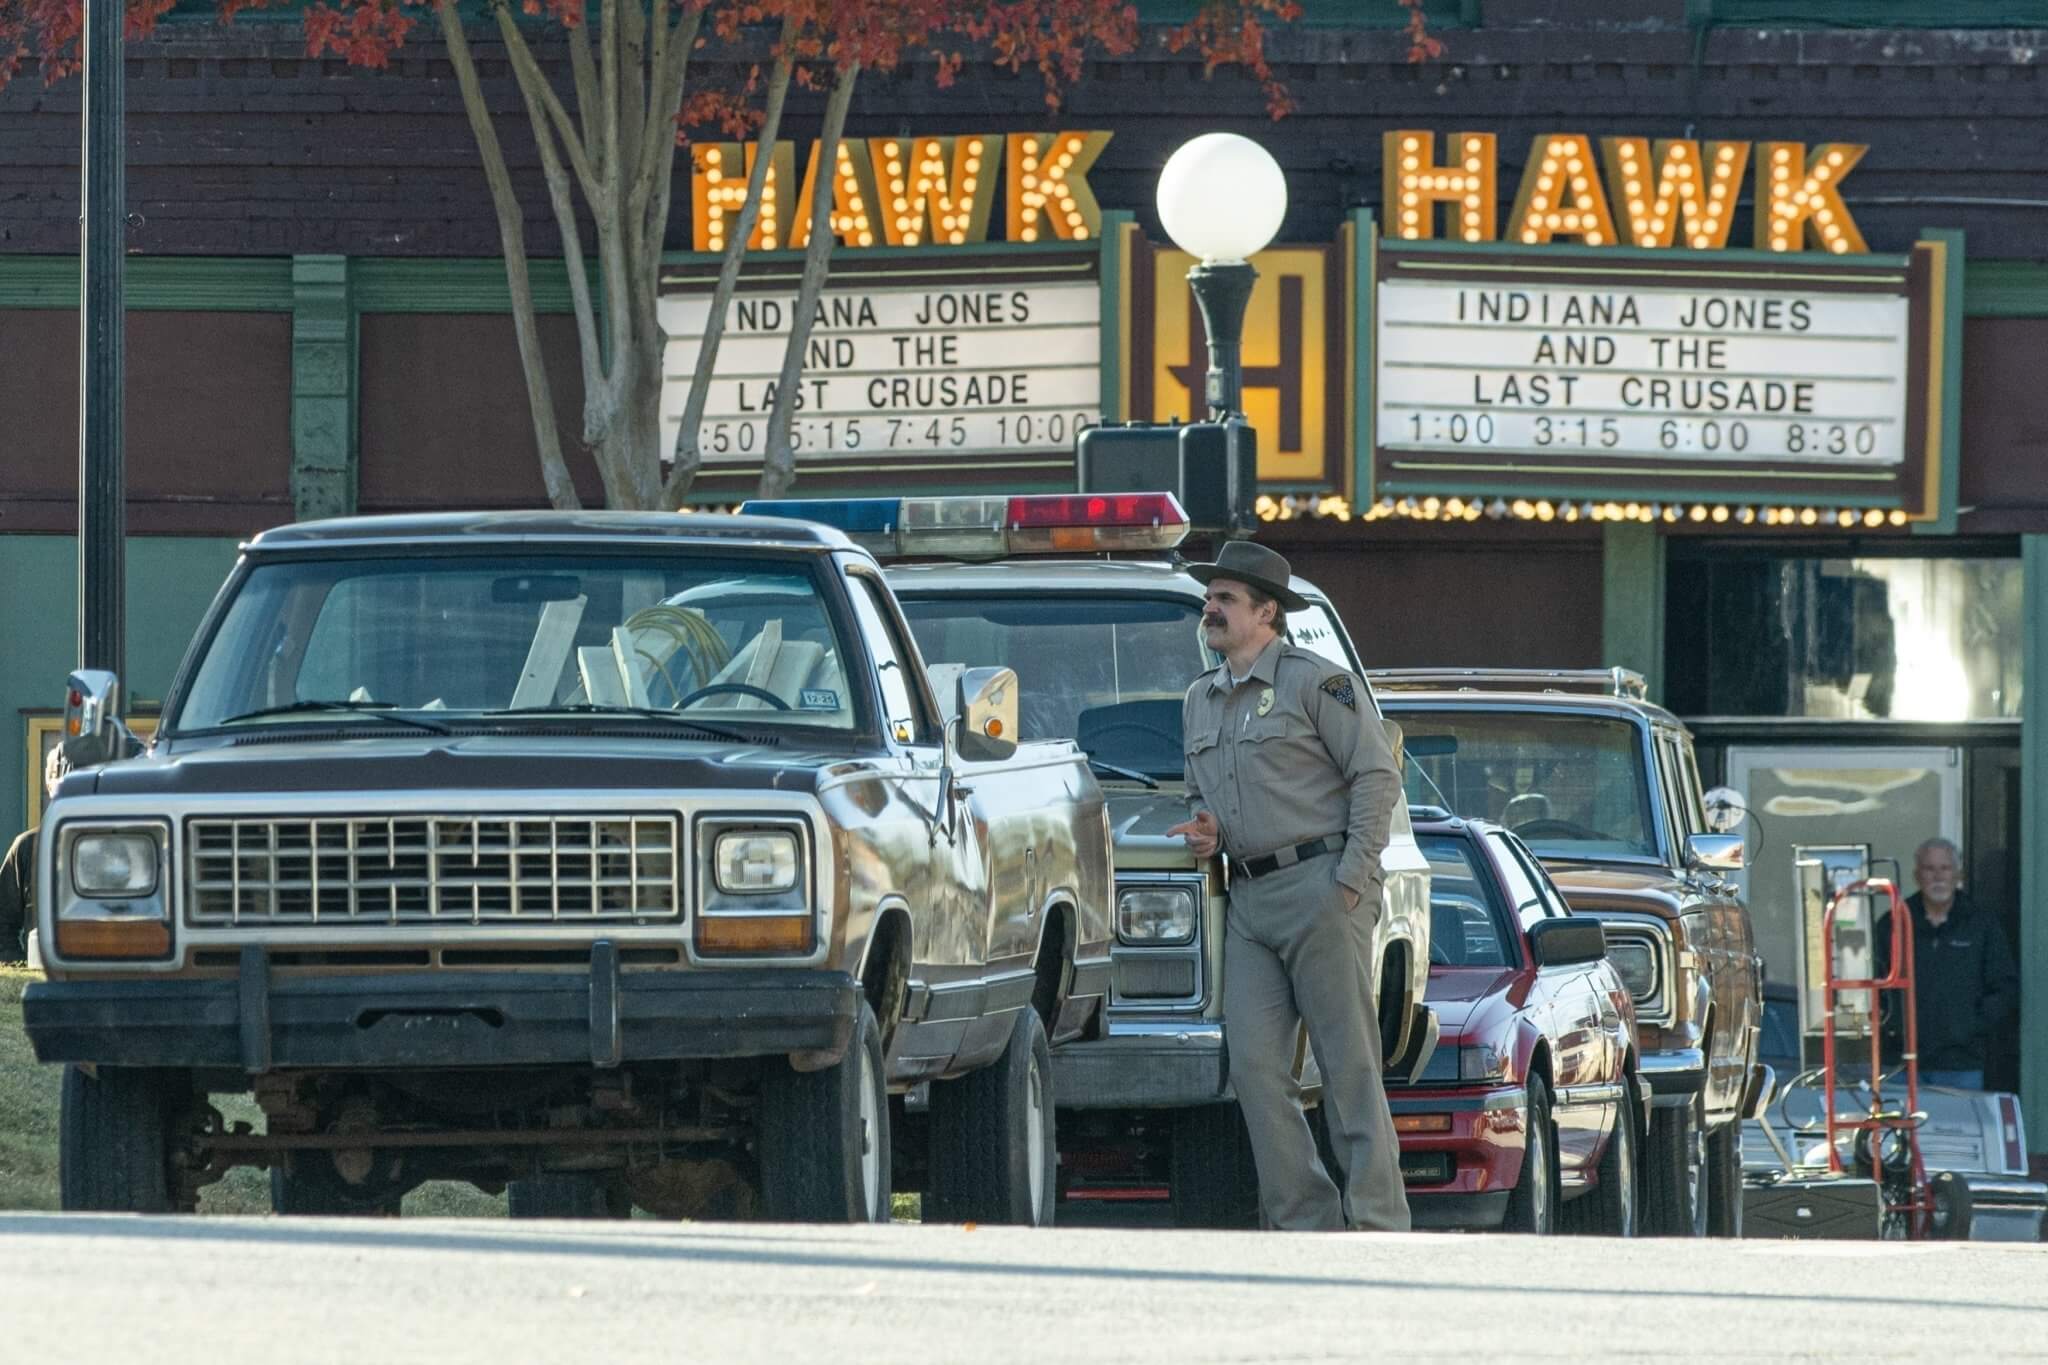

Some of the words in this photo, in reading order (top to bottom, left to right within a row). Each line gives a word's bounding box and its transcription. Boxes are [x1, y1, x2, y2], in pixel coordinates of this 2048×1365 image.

[691, 130, 1112, 252] HAWK
[1383, 130, 1869, 253] HAWK
[722, 297, 878, 331] NDIANA
[915, 291, 1030, 325] JONES
[1457, 291, 1641, 326] INDIANA
[1680, 297, 1812, 331] JONES
[800, 338, 855, 369] ND
[892, 335, 959, 367] THE
[1533, 334, 1616, 366] AND
[1650, 338, 1727, 370] THE
[867, 374, 1029, 409] CRUSADE
[1474, 373, 1579, 405] LAST
[1620, 376, 1815, 414] CRUSADE
[887, 416, 967, 447] 7:45
[1409, 413, 1494, 445] 1:00
[1533, 416, 1619, 448] 3:15
[1660, 419, 1749, 452] 6:00
[1786, 423, 1876, 456] 8:30
